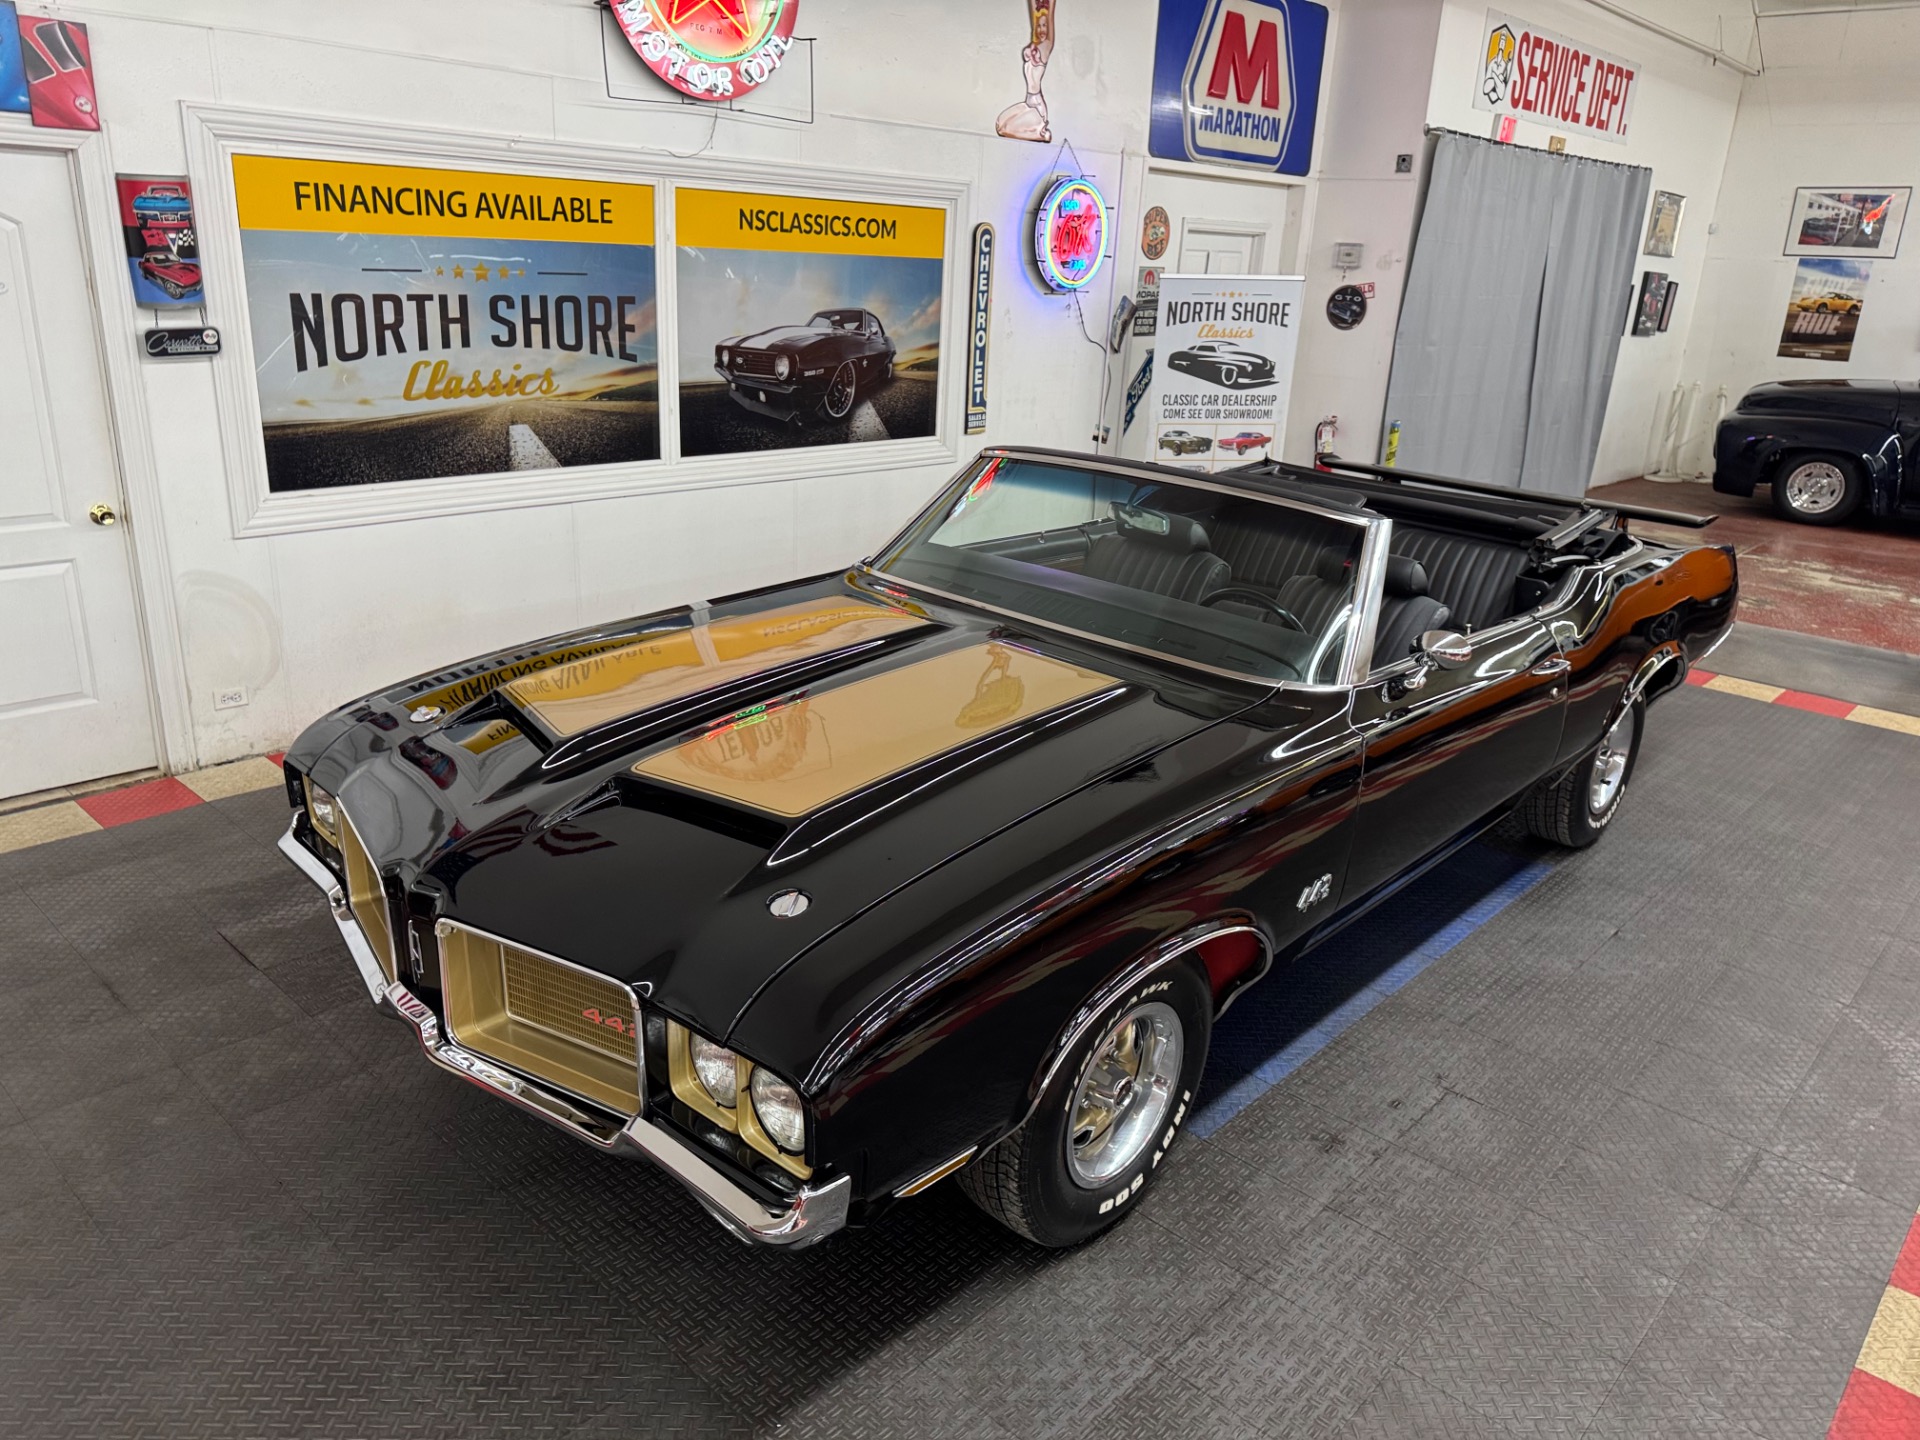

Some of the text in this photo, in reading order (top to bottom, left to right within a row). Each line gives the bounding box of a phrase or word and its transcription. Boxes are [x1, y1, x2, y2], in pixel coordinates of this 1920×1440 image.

[617, 0, 794, 95] MOTOR OIL
[1511, 31, 1635, 136] SERVICE DEPT.
[1199, 104, 1281, 143] MARATHON
[293, 181, 613, 225] FINANCING AVAILABLE
[738, 208, 897, 241] NSCLASSICS.COM
[1146, 239, 1165, 257] BEE
[1166, 301, 1291, 328] NORTH SHORE
[1335, 294, 1362, 302] GTO
[290, 292, 638, 373] NORTH SHORE
[973, 234, 991, 404] CHEVROLET
[1197, 323, 1255, 339] Classics
[1792, 311, 1841, 335] RIDE
[403, 360, 560, 402] Classics
[1162, 394, 1277, 406] CLASSIC CAR DEALERSHIP
[1163, 408, 1273, 419] COME SEE OUR SHOWROOM!
[1098, 1173, 1144, 1215] 500
